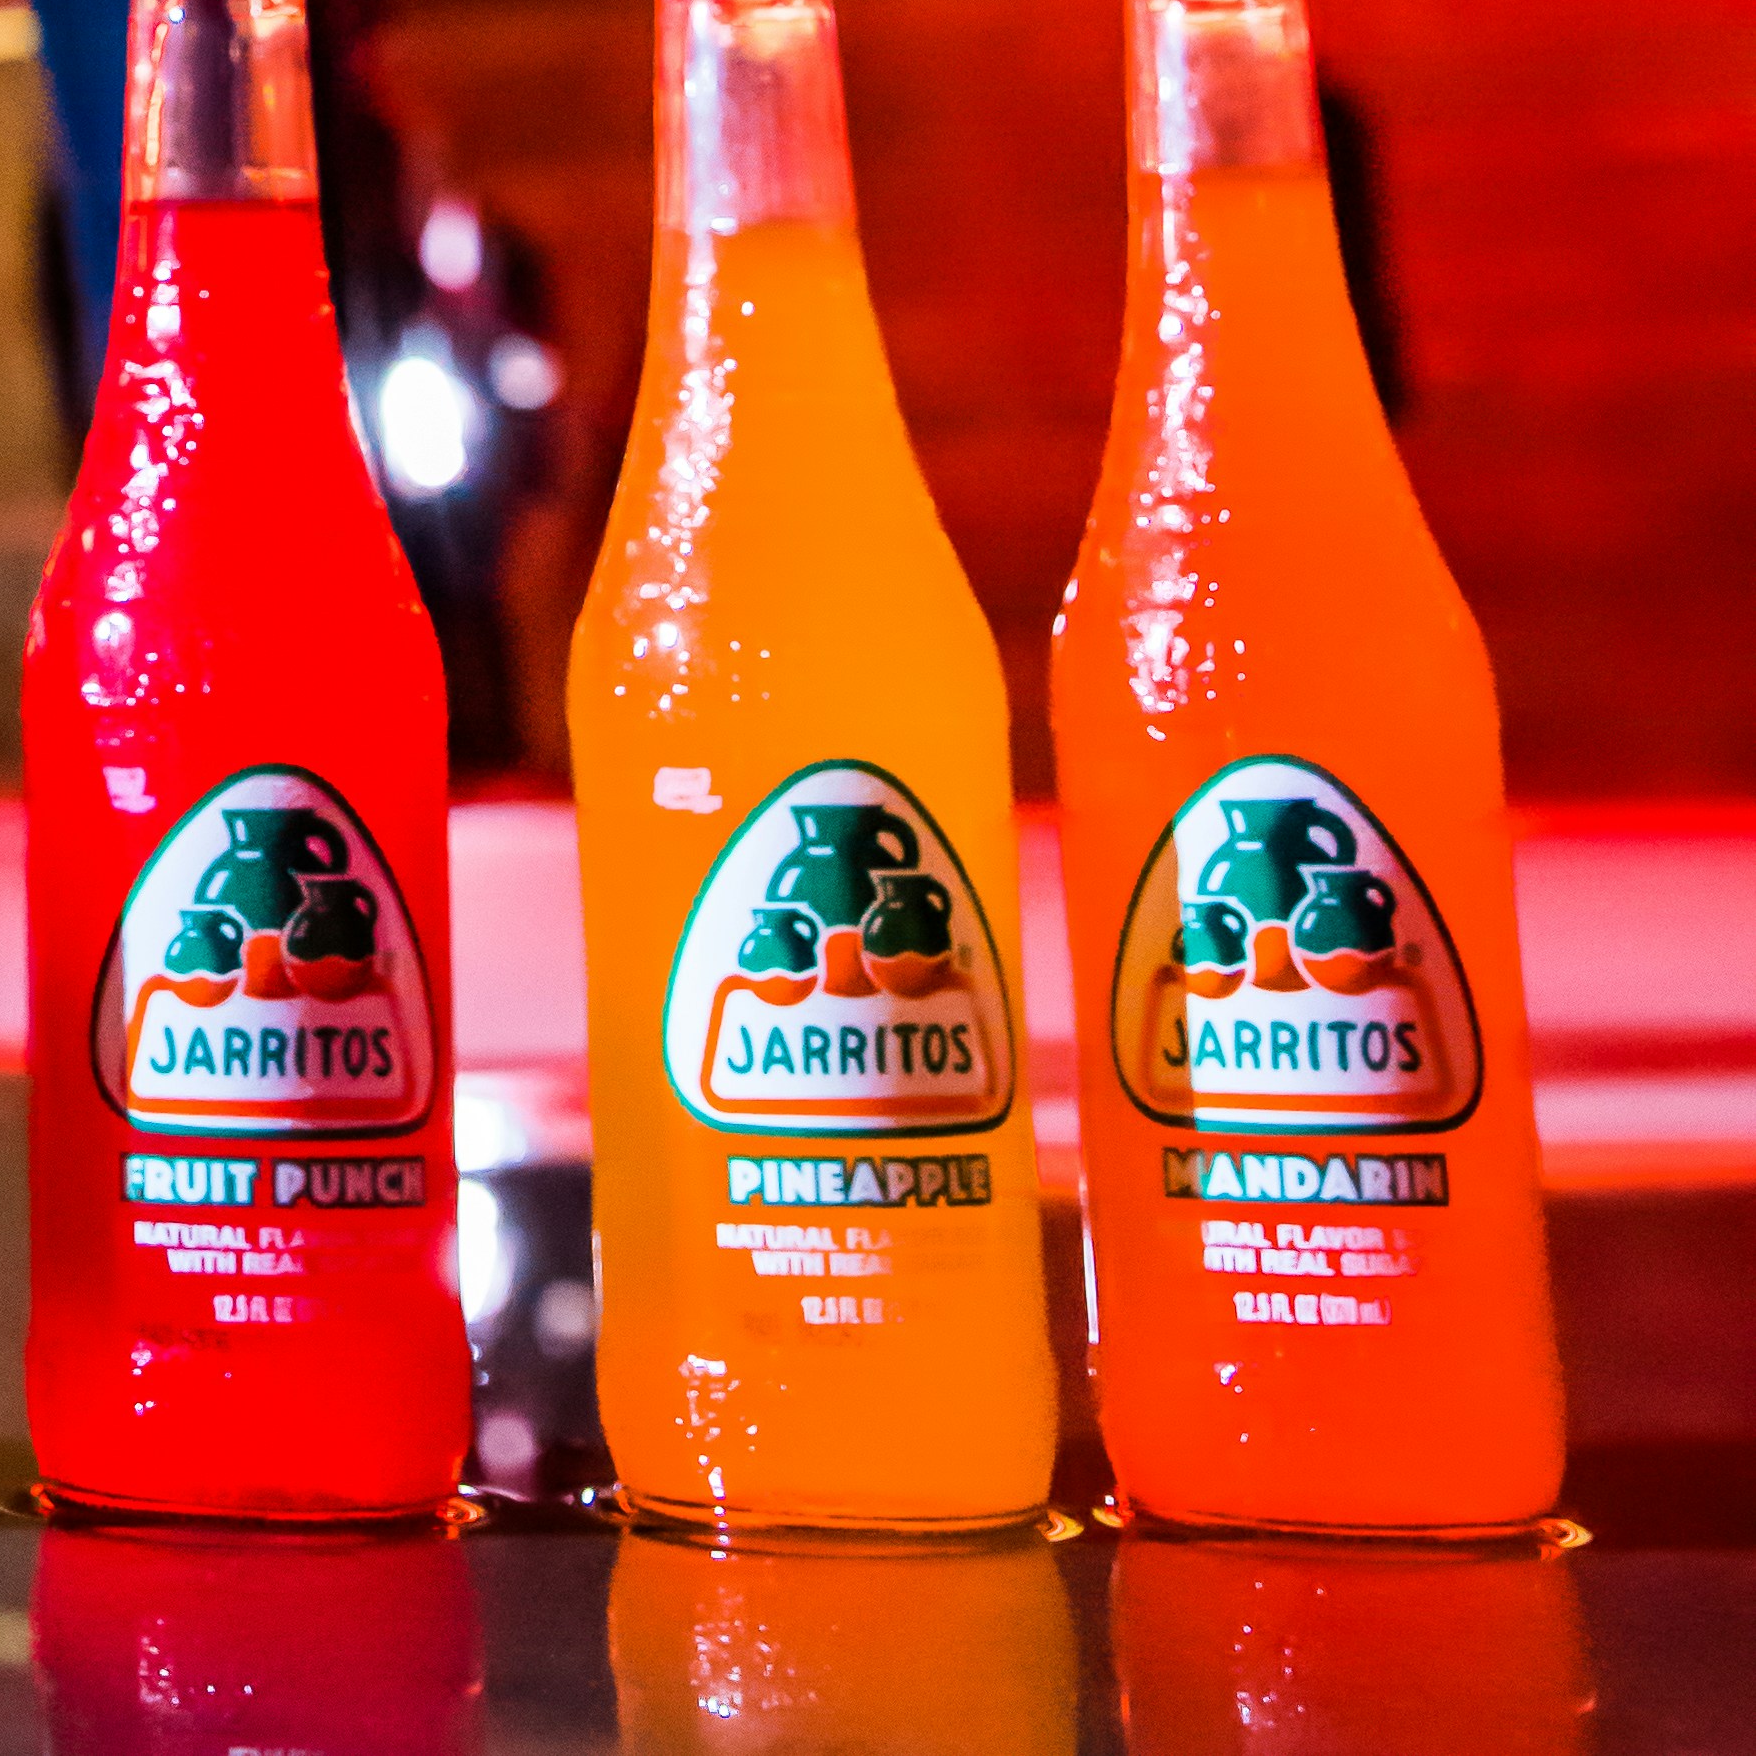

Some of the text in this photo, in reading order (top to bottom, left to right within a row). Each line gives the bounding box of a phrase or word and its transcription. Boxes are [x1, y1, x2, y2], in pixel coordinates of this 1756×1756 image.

[150, 1026, 394, 1078] JARRITOS
[726, 1024, 973, 1076] JARRITOS
[1162, 1016, 1422, 1073] JARRITOS
[126, 1156, 259, 1205] FRUIT
[729, 1156, 990, 1206] PINEAPPLE
[1164, 1149, 1447, 1205] MANDARIN
[133, 1220, 252, 1250] NATURAL
[716, 1222, 839, 1252] NATURAL
[1276, 1222, 1386, 1252] FLAVOR
[166, 1248, 237, 1274] WITH
[751, 1251, 825, 1277] WITH
[1260, 1248, 1336, 1277] REAL
